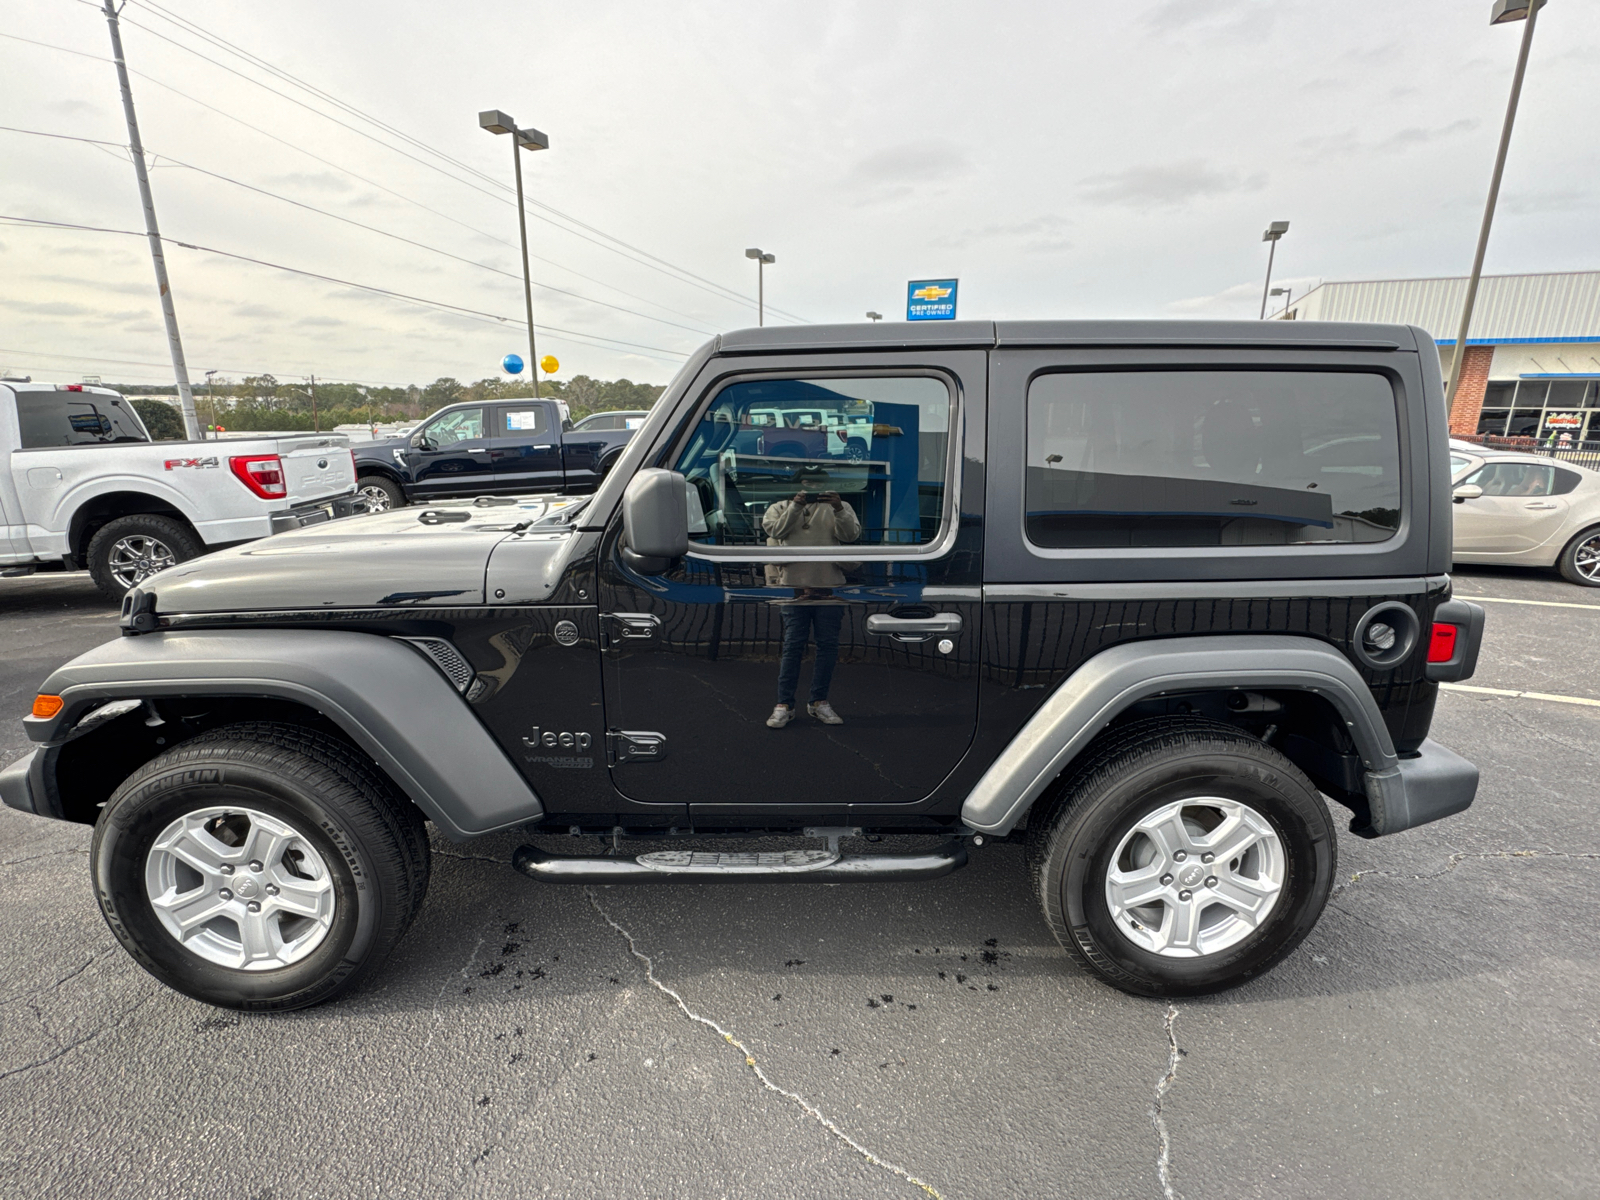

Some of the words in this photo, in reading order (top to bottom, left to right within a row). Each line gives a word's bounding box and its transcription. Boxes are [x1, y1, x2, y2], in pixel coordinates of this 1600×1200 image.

[164, 456, 220, 471] FX4
[302, 470, 346, 488] F-150
[522, 726, 593, 752] Jeep
[130, 769, 218, 807] MICHELIN
[1262, 773, 1326, 837] MICHELIN
[1076, 931, 1138, 986] MICHELIN
